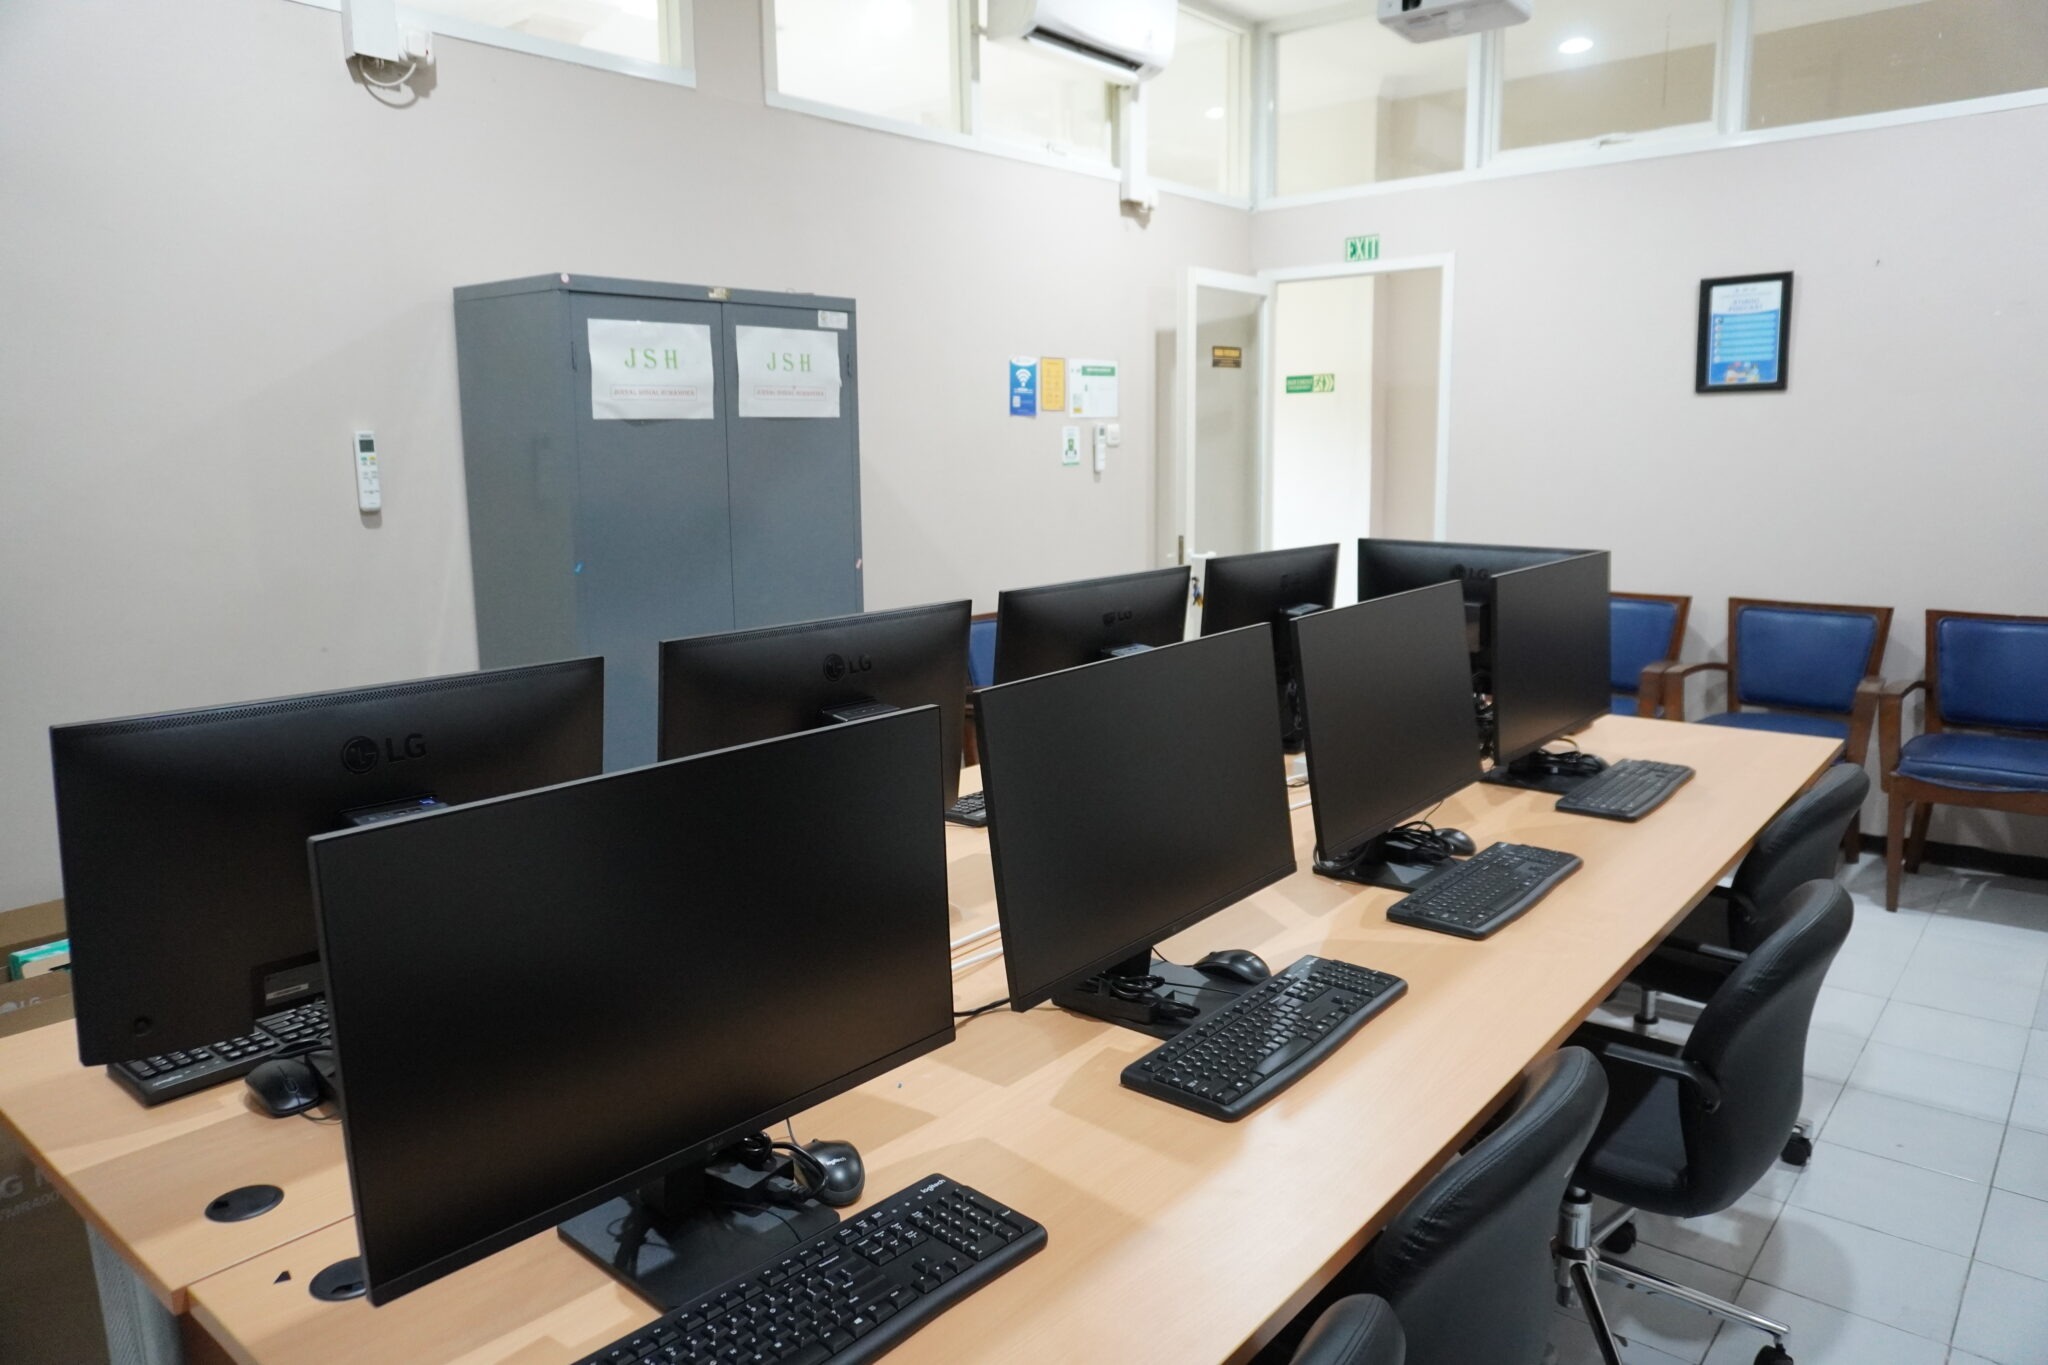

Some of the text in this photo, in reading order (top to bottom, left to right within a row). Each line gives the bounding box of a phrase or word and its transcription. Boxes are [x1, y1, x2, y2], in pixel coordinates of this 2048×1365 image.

[1348, 236, 1379, 261] EXIT
[624, 348, 679, 370] JSH
[766, 352, 812, 372] JSH
[385, 733, 427, 763] LG
[920, 1179, 946, 1194] logitech
